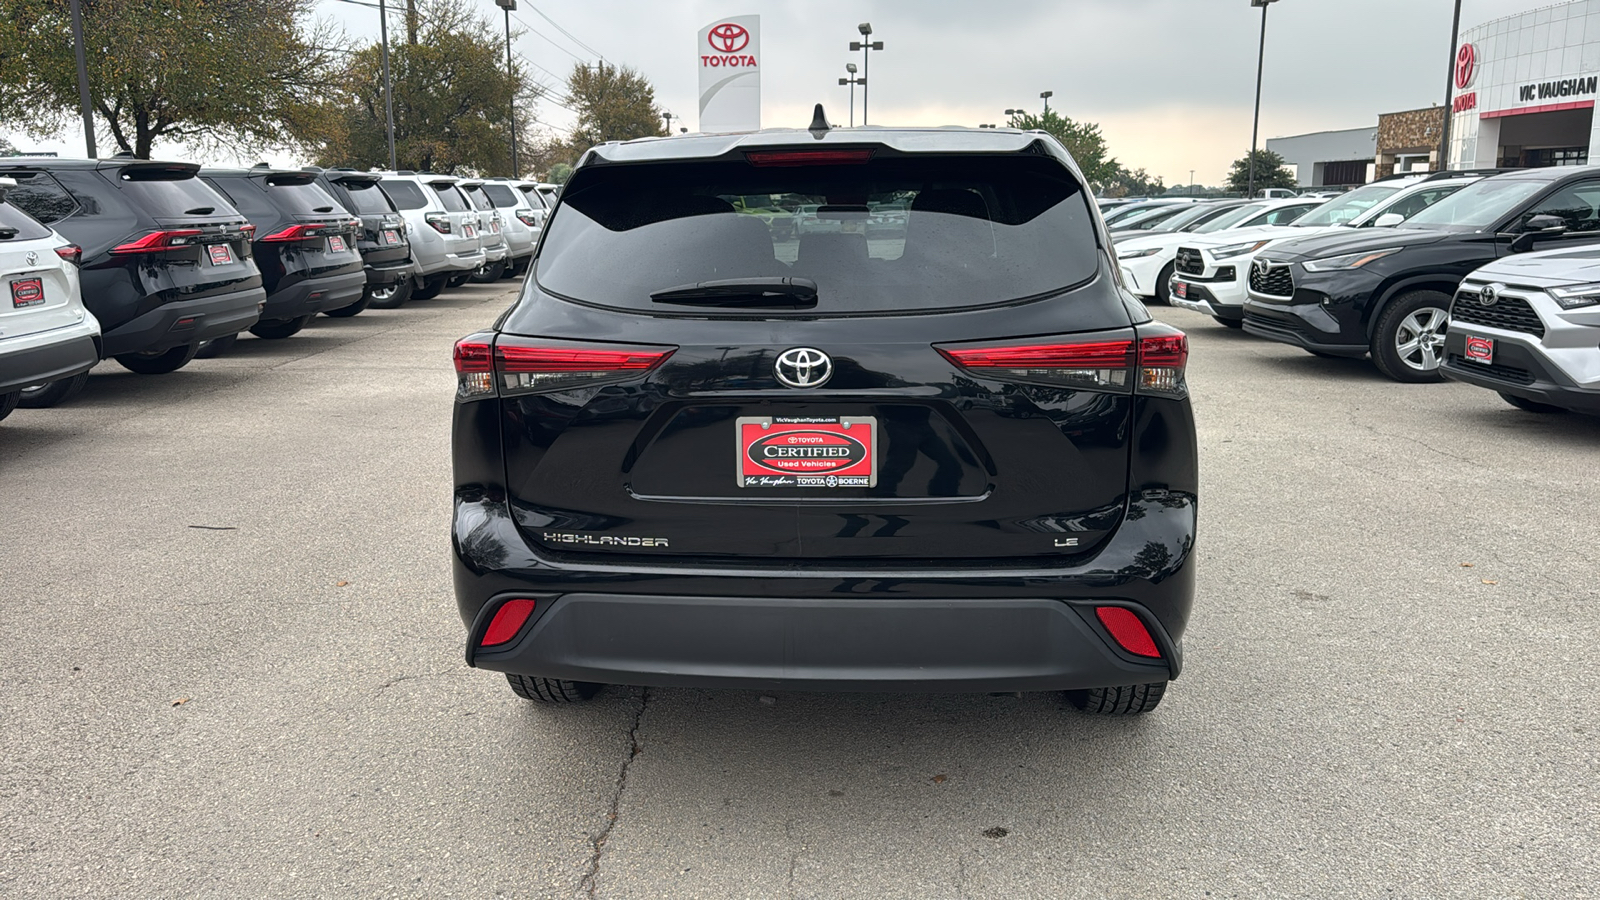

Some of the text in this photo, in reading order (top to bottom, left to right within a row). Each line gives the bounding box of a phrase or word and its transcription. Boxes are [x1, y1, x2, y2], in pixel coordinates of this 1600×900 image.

[701, 55, 757, 67] TOYOTA
[1519, 76, 1598, 102] VIC VAUGHAN
[763, 445, 850, 457] CERTIFIED
[543, 532, 669, 547] HIGHLANDER
[1054, 537, 1079, 547] LE
